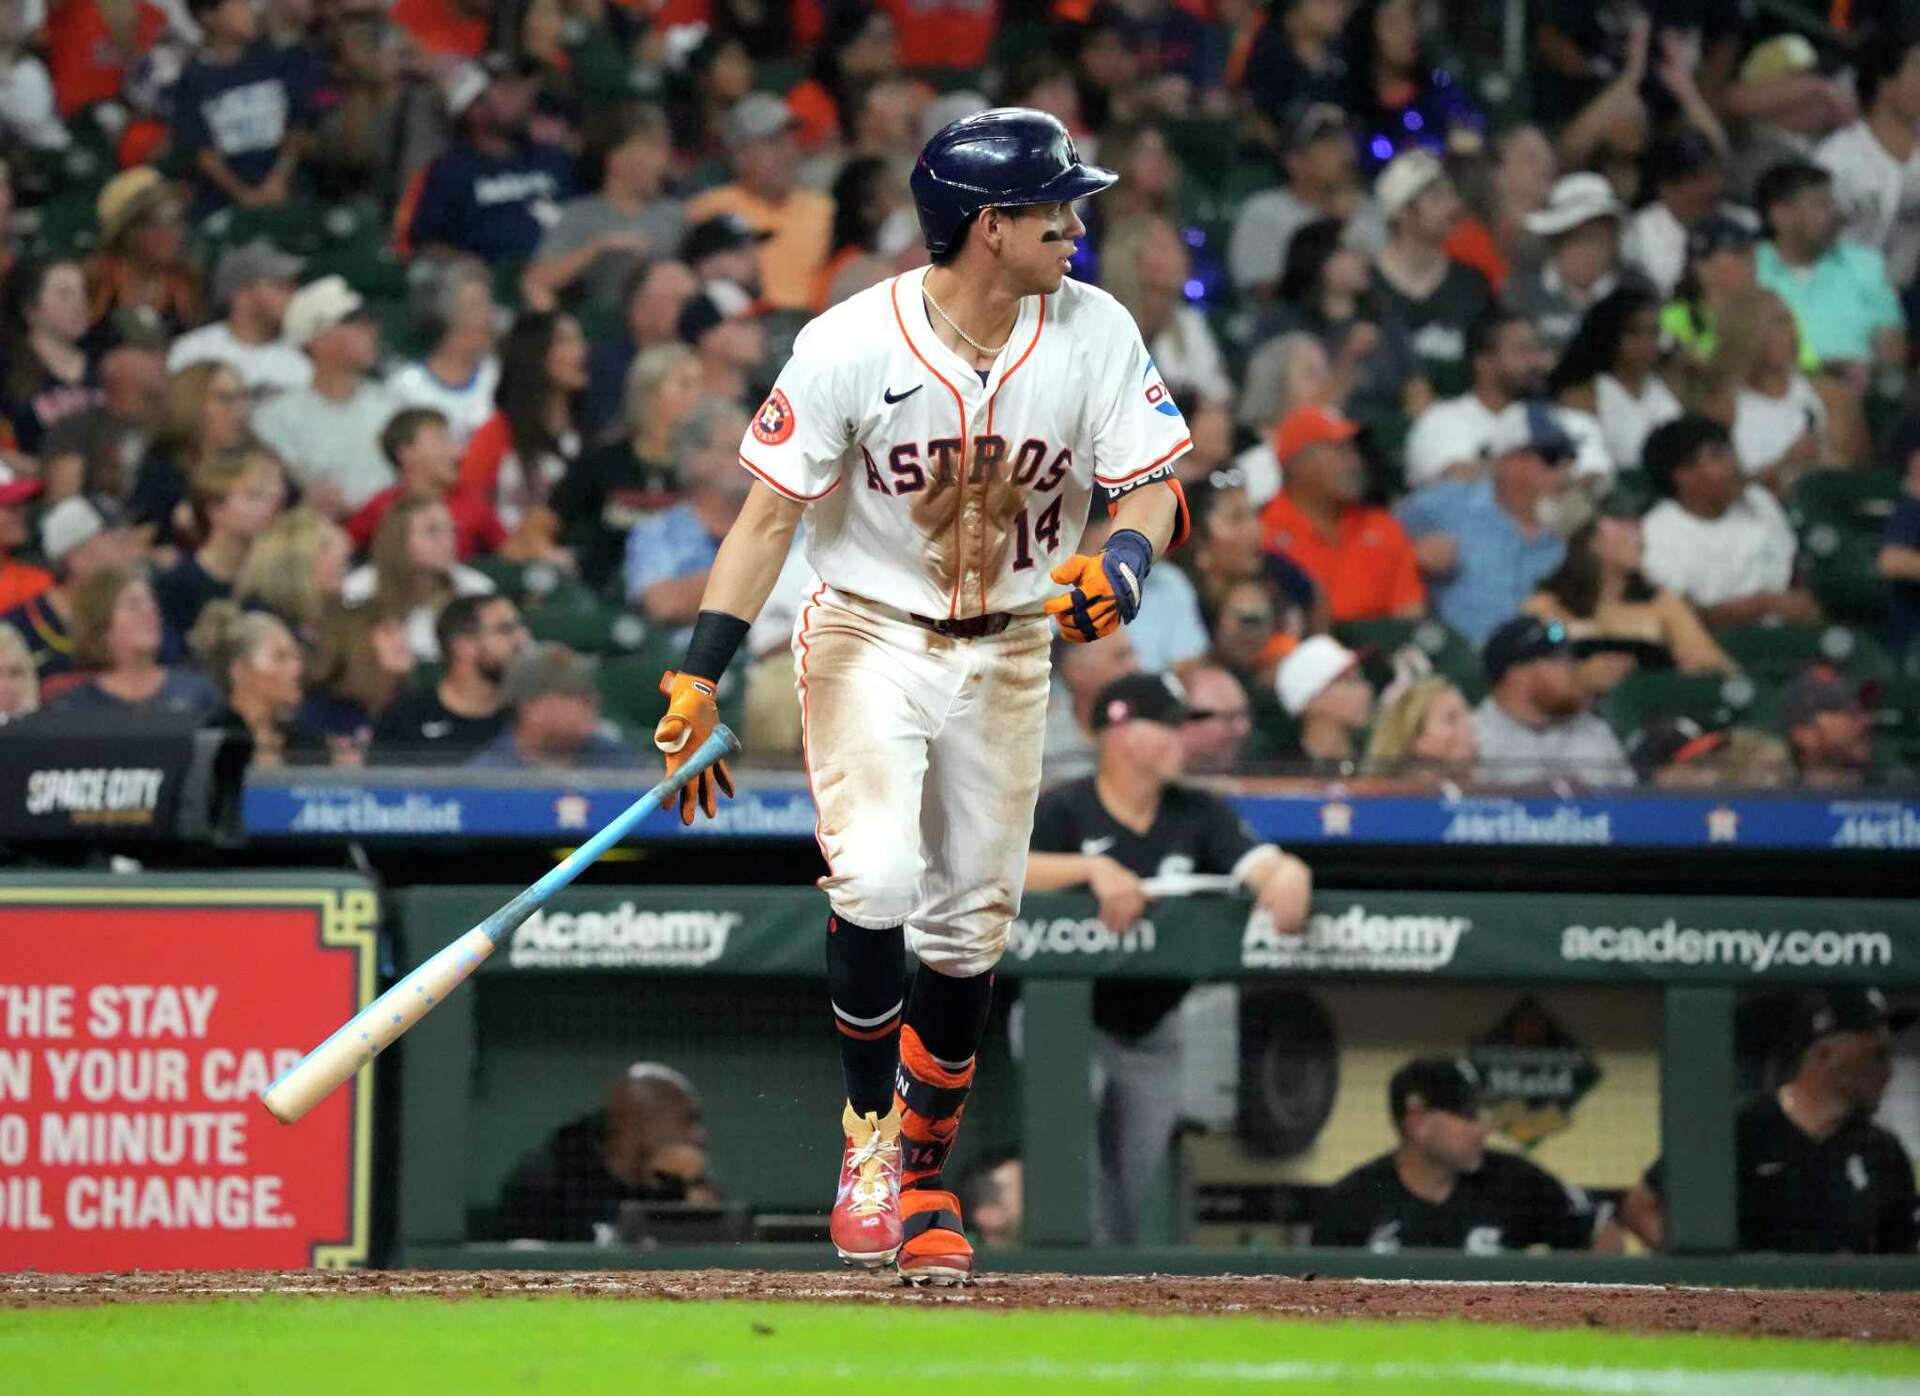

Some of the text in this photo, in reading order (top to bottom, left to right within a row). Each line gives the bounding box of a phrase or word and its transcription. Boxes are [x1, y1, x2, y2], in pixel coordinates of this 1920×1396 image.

[861, 434, 1072, 496] ASTROS
[1012, 493, 1064, 572] 14
[510, 901, 743, 963] Academy
[1560, 917, 1894, 973] academy.com
[0, 984, 218, 1038] HE STAY
[44, 1048, 189, 1102] YOUR
[40, 1111, 248, 1166] MINUTE
[911, 1148, 934, 1165] 14
[0, 1174, 297, 1230] IL CHANGE.
